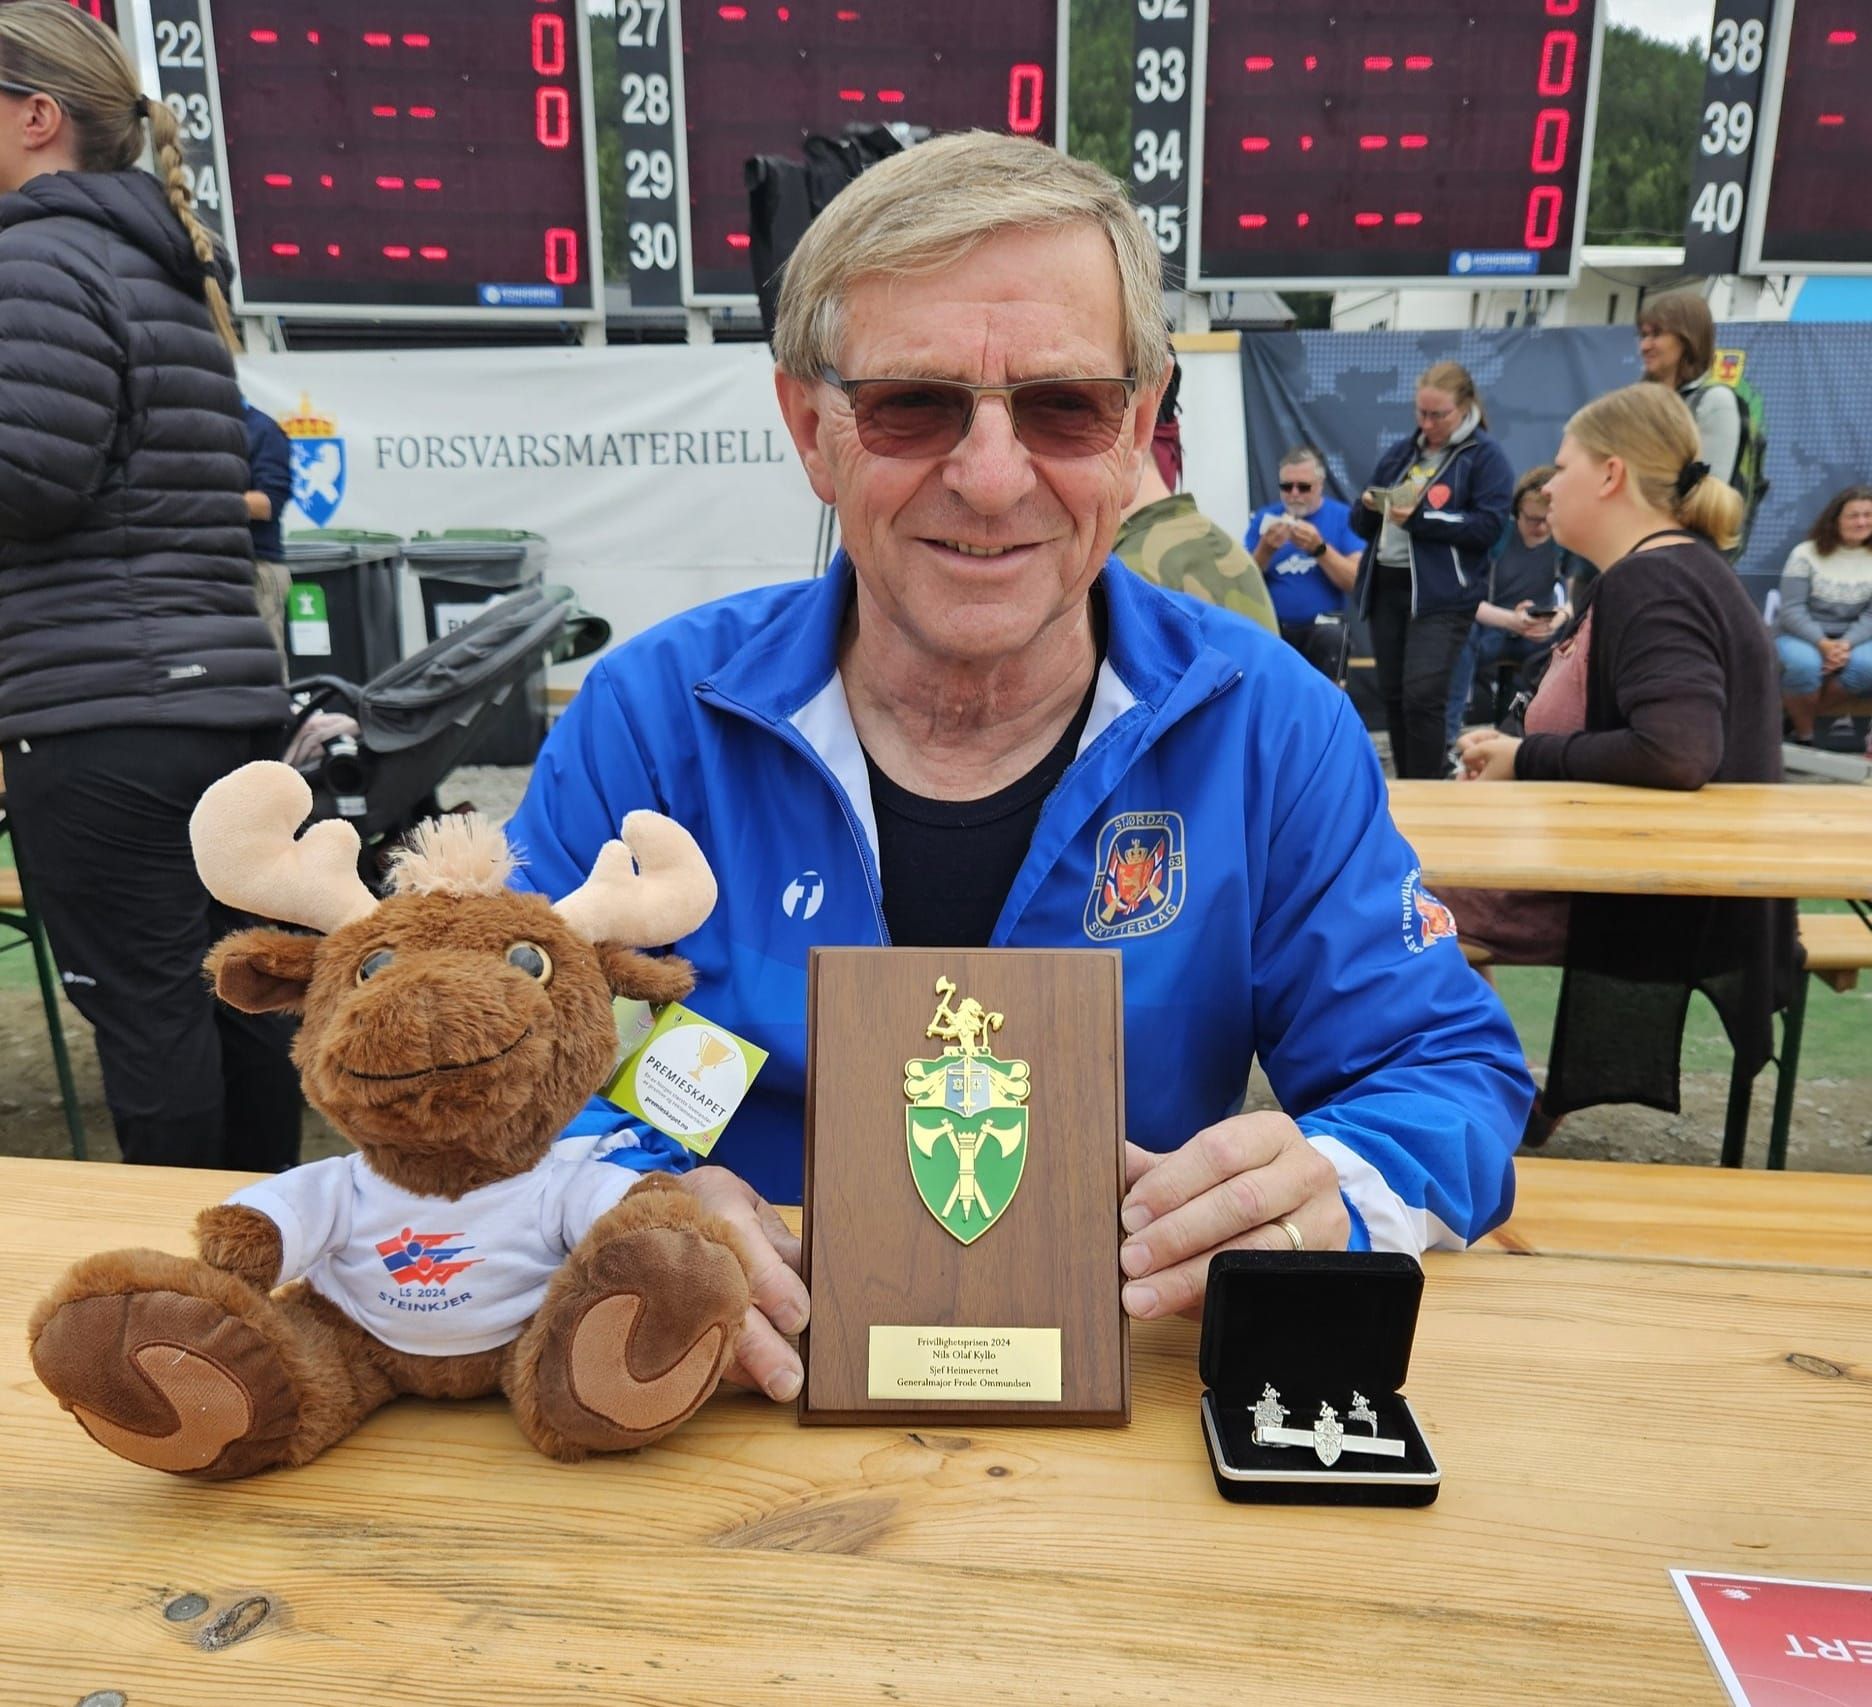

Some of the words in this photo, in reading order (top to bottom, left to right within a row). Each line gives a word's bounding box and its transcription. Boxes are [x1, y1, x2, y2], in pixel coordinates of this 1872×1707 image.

[156, 20, 204, 67] 22
[532, 13, 565, 76] 0
[617, 0, 665, 47] 27
[1711, 19, 1764, 74] 38
[1135, 47, 1186, 103] 33
[1538, 30, 1578, 96] 0
[536, 86, 570, 148] 0
[621, 72, 671, 126] 28
[1009, 64, 1042, 132] 0
[1531, 108, 1570, 173] 0
[1701, 101, 1754, 155] 39
[625, 149, 674, 200] 29
[1133, 129, 1183, 183] 34
[1524, 185, 1563, 249] 0
[1690, 181, 1744, 234] 40
[544, 227, 578, 285] 0
[629, 222, 677, 270] 30
[375, 429, 785, 470] FORSVARSMATERIELL
[1114, 815, 1169, 831] STJØRDAL
[1168, 856, 1182, 867] 63
[1088, 902, 1177, 937] SKYTTERLAG
[646, 1055, 727, 1118] PREMIESKAPET
[378, 1291, 473, 1312] STEINKJER
[399, 1287, 412, 1297] LS
[417, 1287, 446, 1298] 2024
[917, 1337, 989, 1349] Frivillighetsprisen
[990, 1338, 1011, 1347] 2024
[932, 1350, 950, 1359] Nils
[952, 1350, 972, 1360] Olaf
[973, 1350, 996, 1362] Kyllo
[897, 1378, 951, 1390] Generalmajor
[954, 1378, 977, 1387] Frode
[979, 1378, 1031, 1388] Ommundsen
[929, 1365, 945, 1376] Sjef
[946, 1366, 998, 1375] Heimevernet
